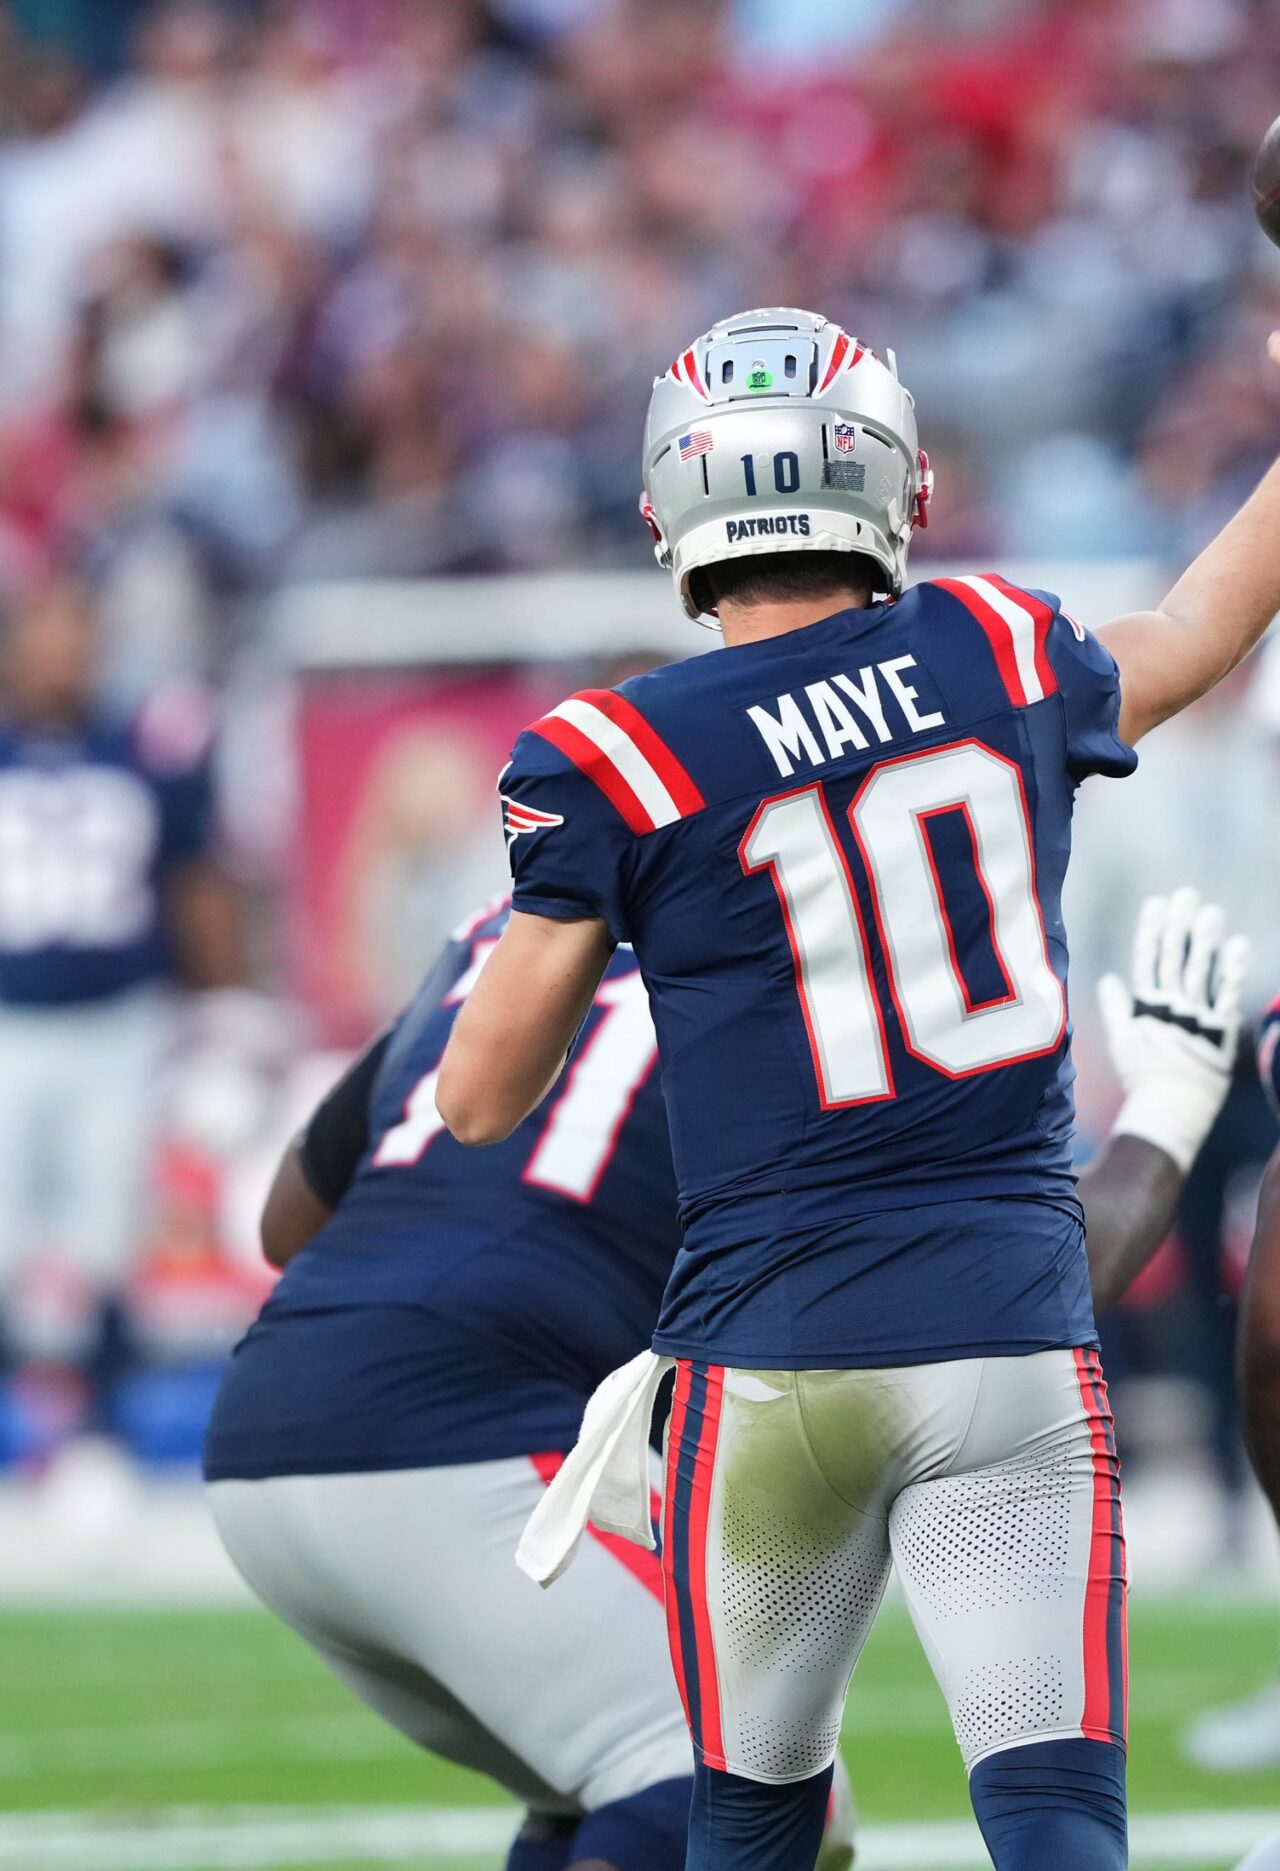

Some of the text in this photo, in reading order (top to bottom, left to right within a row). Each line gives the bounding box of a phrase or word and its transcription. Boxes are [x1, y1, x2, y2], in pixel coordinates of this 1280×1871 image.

[836, 435, 853, 451] NFL
[740, 451, 800, 496] 10
[726, 514, 810, 543] PATRIOTS
[746, 653, 945, 777] MAYE
[737, 737, 1067, 1110] 10
